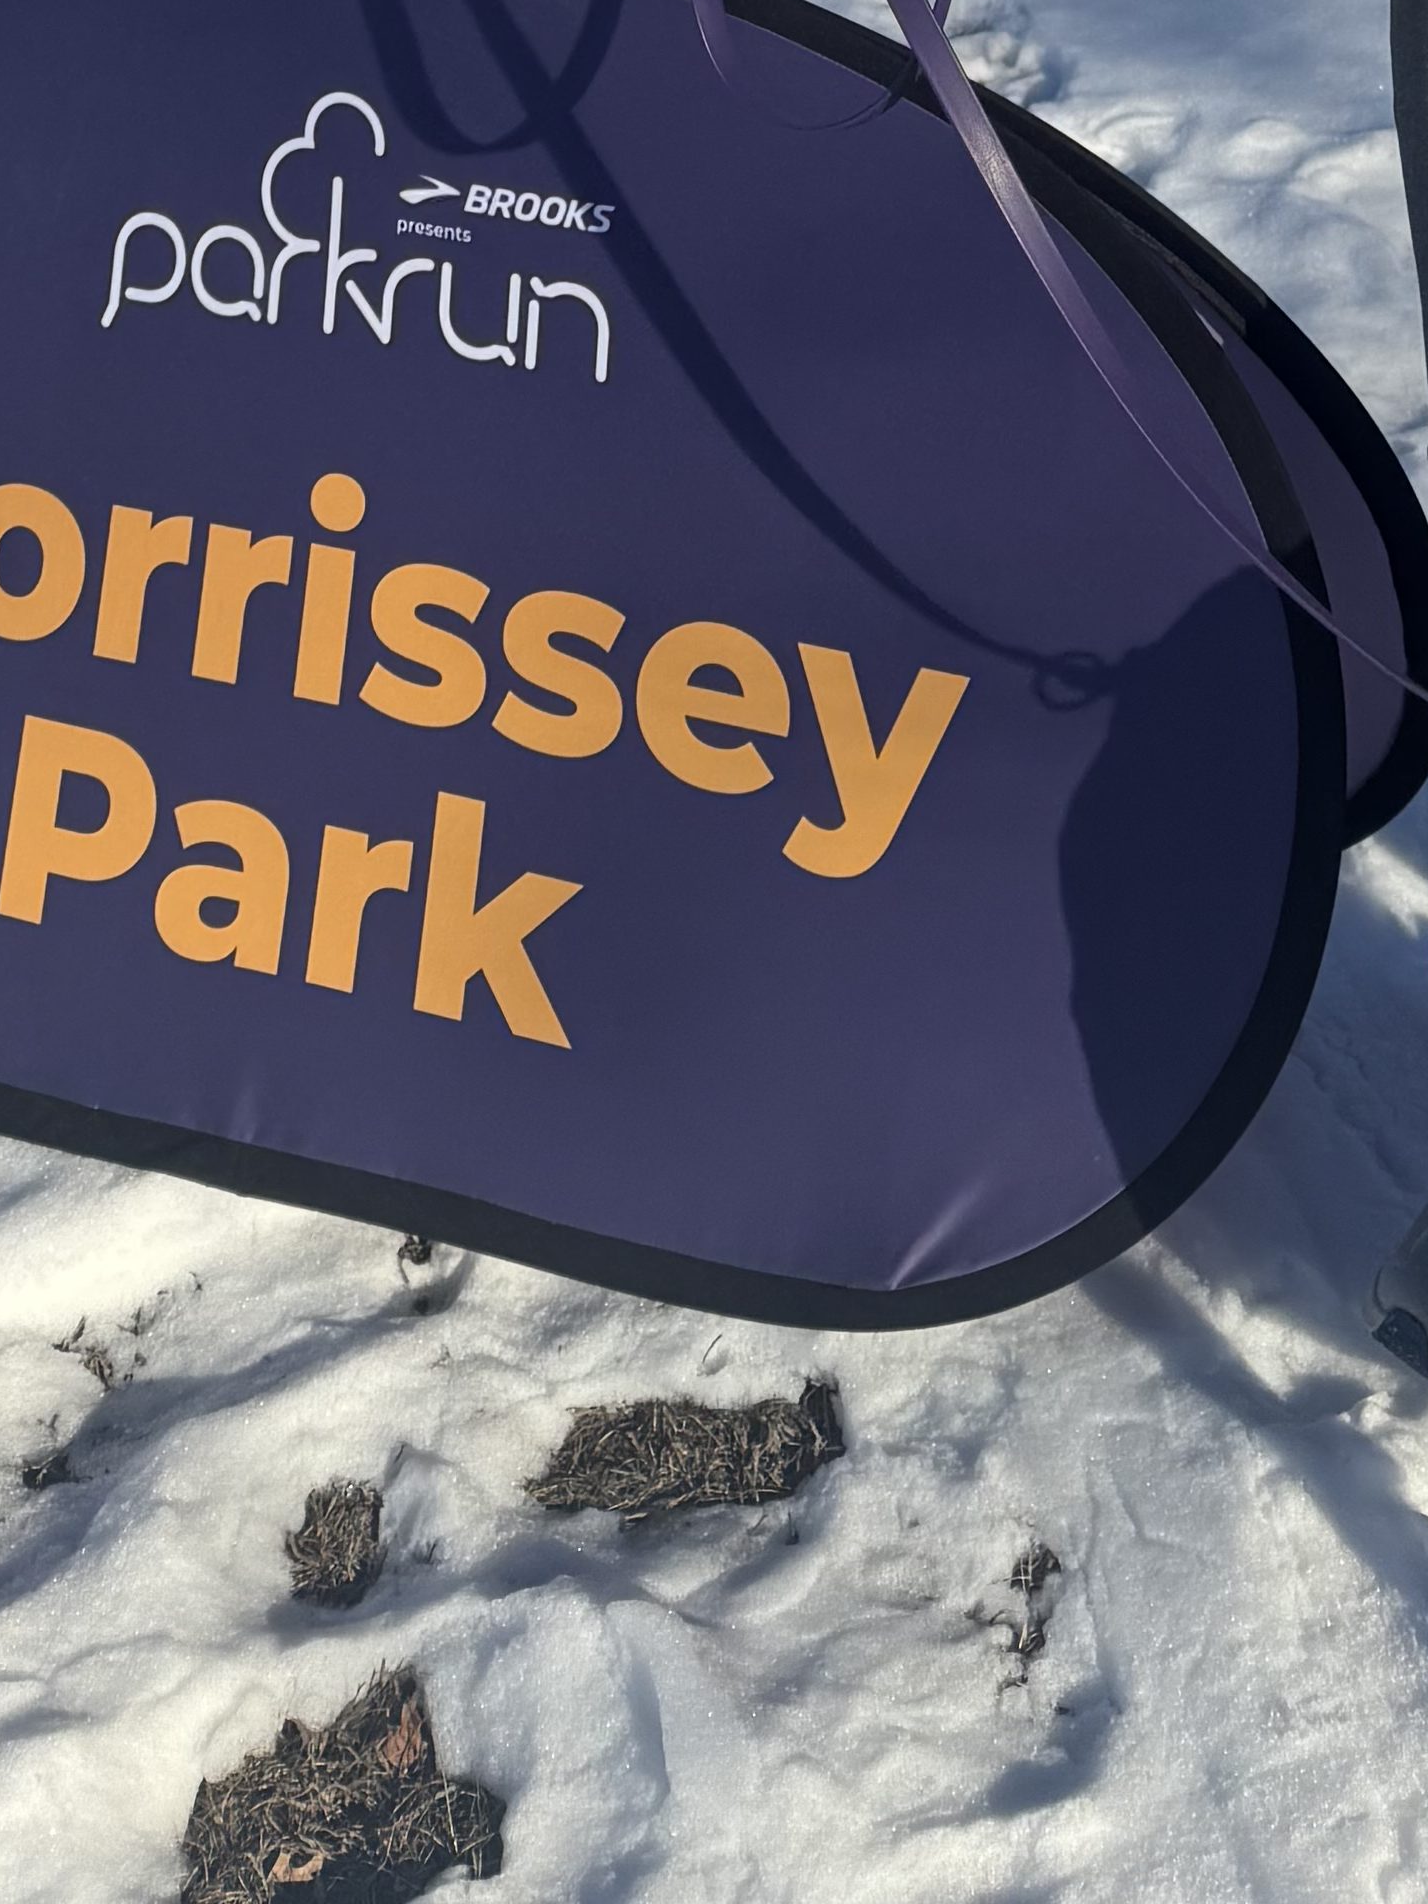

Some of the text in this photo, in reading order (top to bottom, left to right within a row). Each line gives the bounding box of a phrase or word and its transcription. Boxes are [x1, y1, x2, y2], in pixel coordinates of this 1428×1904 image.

[396, 216, 472, 244] presents
[463, 183, 616, 234] BROOKS
[100, 176, 610, 383] parkrun
